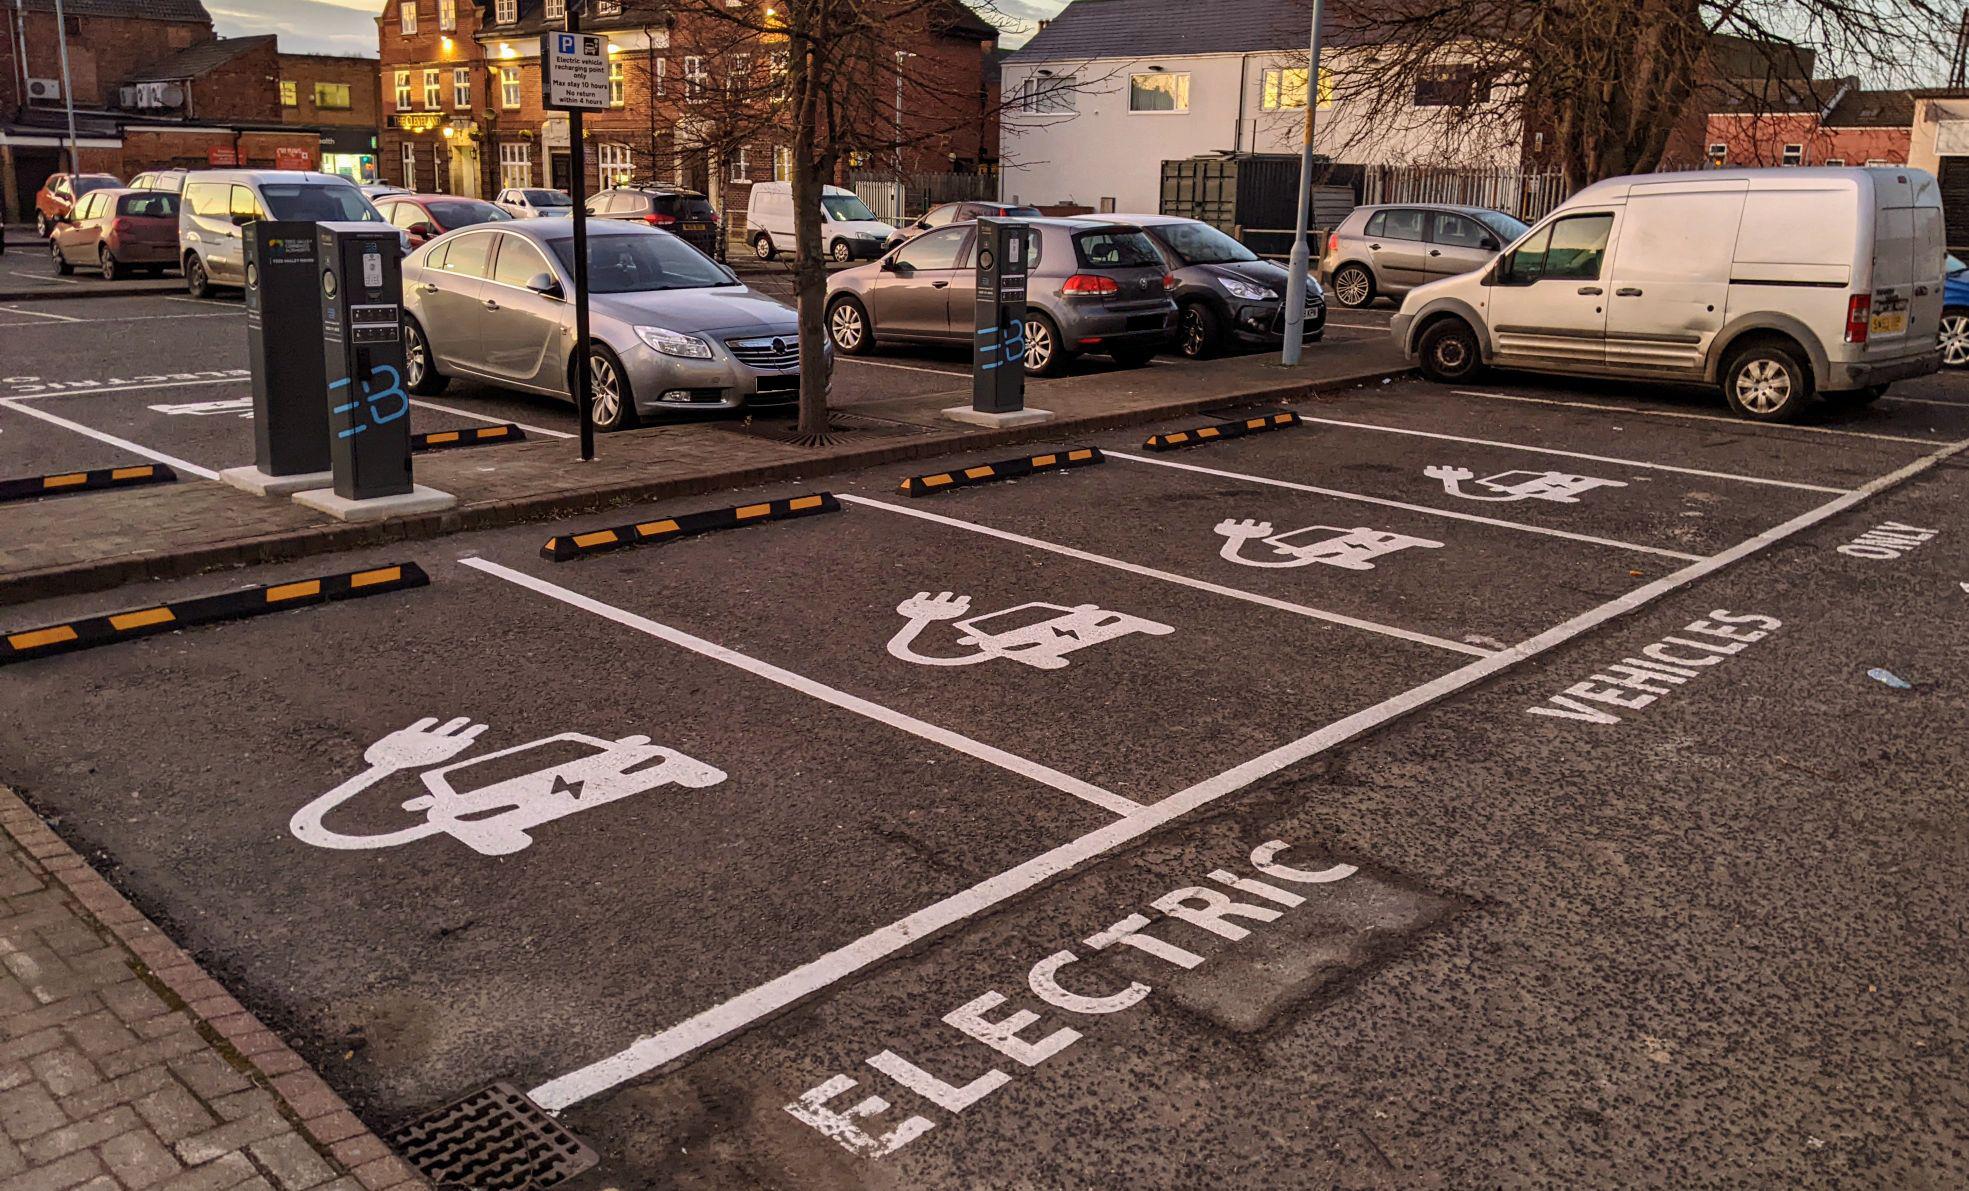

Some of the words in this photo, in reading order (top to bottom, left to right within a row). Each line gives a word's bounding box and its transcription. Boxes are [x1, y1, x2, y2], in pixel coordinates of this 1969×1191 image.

[562, 37, 573, 52] P
[556, 56, 581, 64] Electric
[555, 64, 587, 73] recharging
[573, 72, 587, 80] only
[553, 79, 566, 87] Max
[567, 81, 580, 89] stay
[394, 116, 405, 126] THE
[405, 115, 441, 127] CLEVELAND
[783, 839, 1359, 1160] ELECTRIC
[1526, 608, 1783, 725] VEHICLES
[1836, 521, 1939, 560] ONLY
